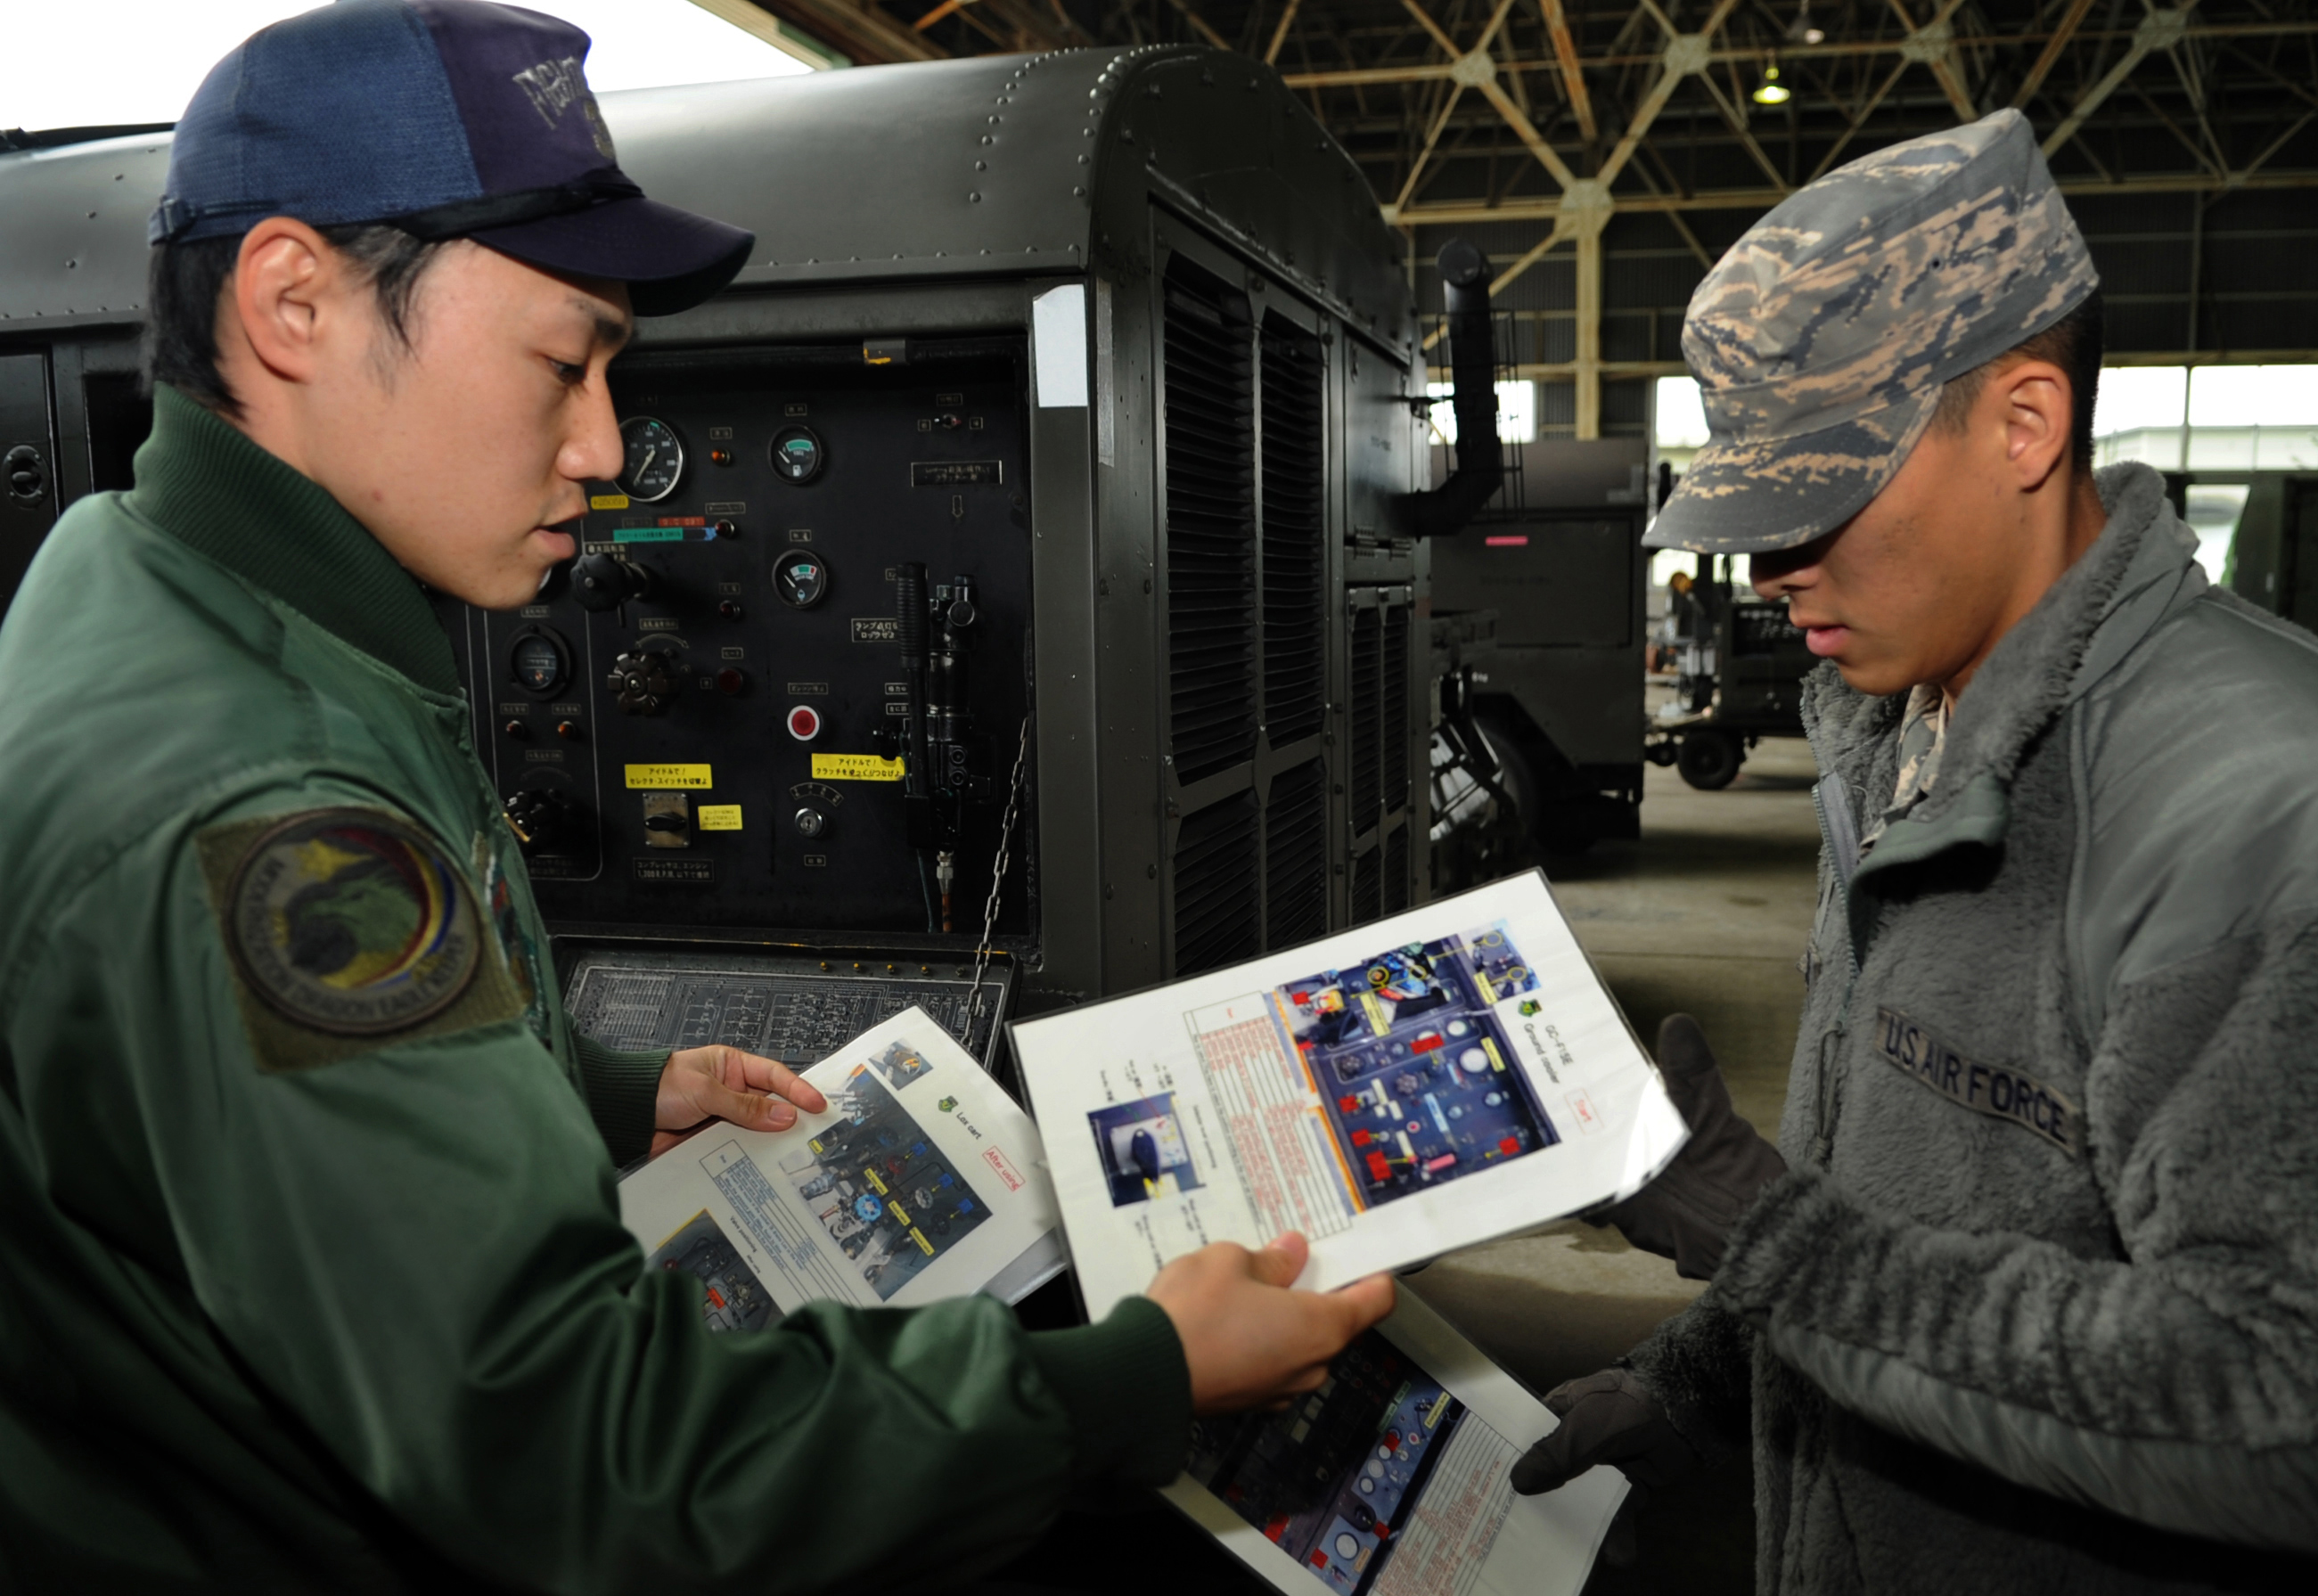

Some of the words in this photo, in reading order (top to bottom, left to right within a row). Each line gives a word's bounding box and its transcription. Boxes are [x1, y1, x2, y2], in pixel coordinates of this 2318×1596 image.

[1523, 1022, 1546, 1055] Ground
[1540, 1056, 1561, 1085] cooler
[1574, 1099, 1593, 1123] Start
[1921, 1041, 1962, 1094] AIR
[1969, 1064, 2068, 1144] FORCE
[956, 1111, 971, 1126] Lox
[967, 1124, 983, 1140] cart
[986, 1149, 1005, 1170] After
[1001, 1167, 1021, 1190] using
